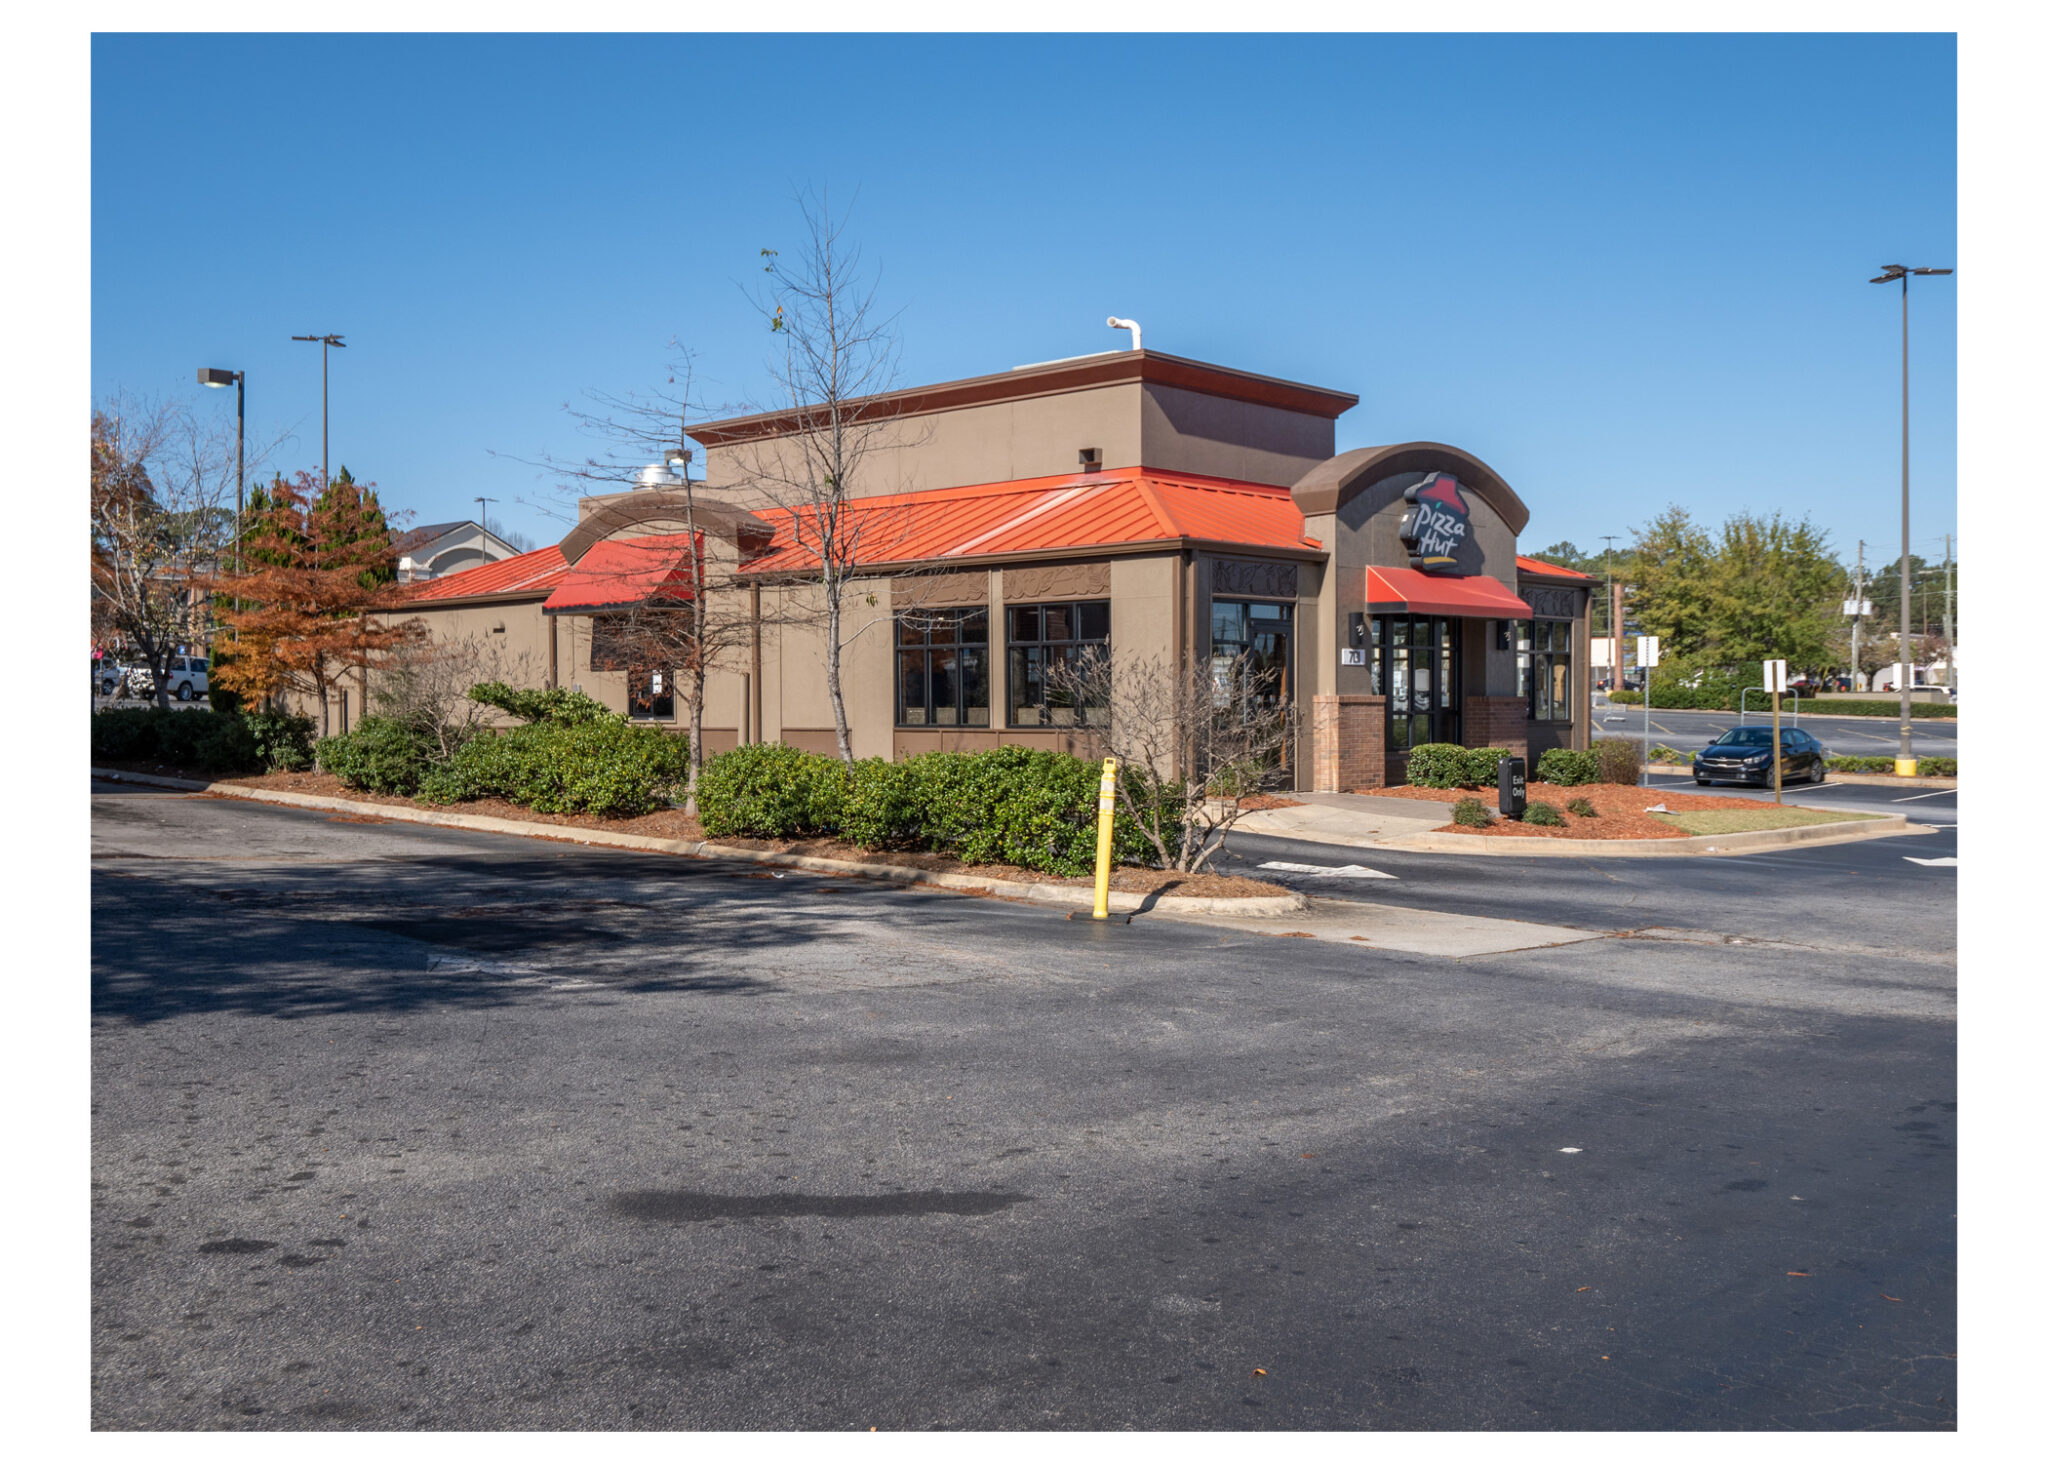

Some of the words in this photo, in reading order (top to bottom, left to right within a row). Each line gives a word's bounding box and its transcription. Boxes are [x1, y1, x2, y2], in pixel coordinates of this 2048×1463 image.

[1413, 502, 1465, 536] Pizza
[1420, 528, 1458, 557] Hut
[1512, 775, 1524, 785] Exit
[1512, 787, 1525, 799] Only
